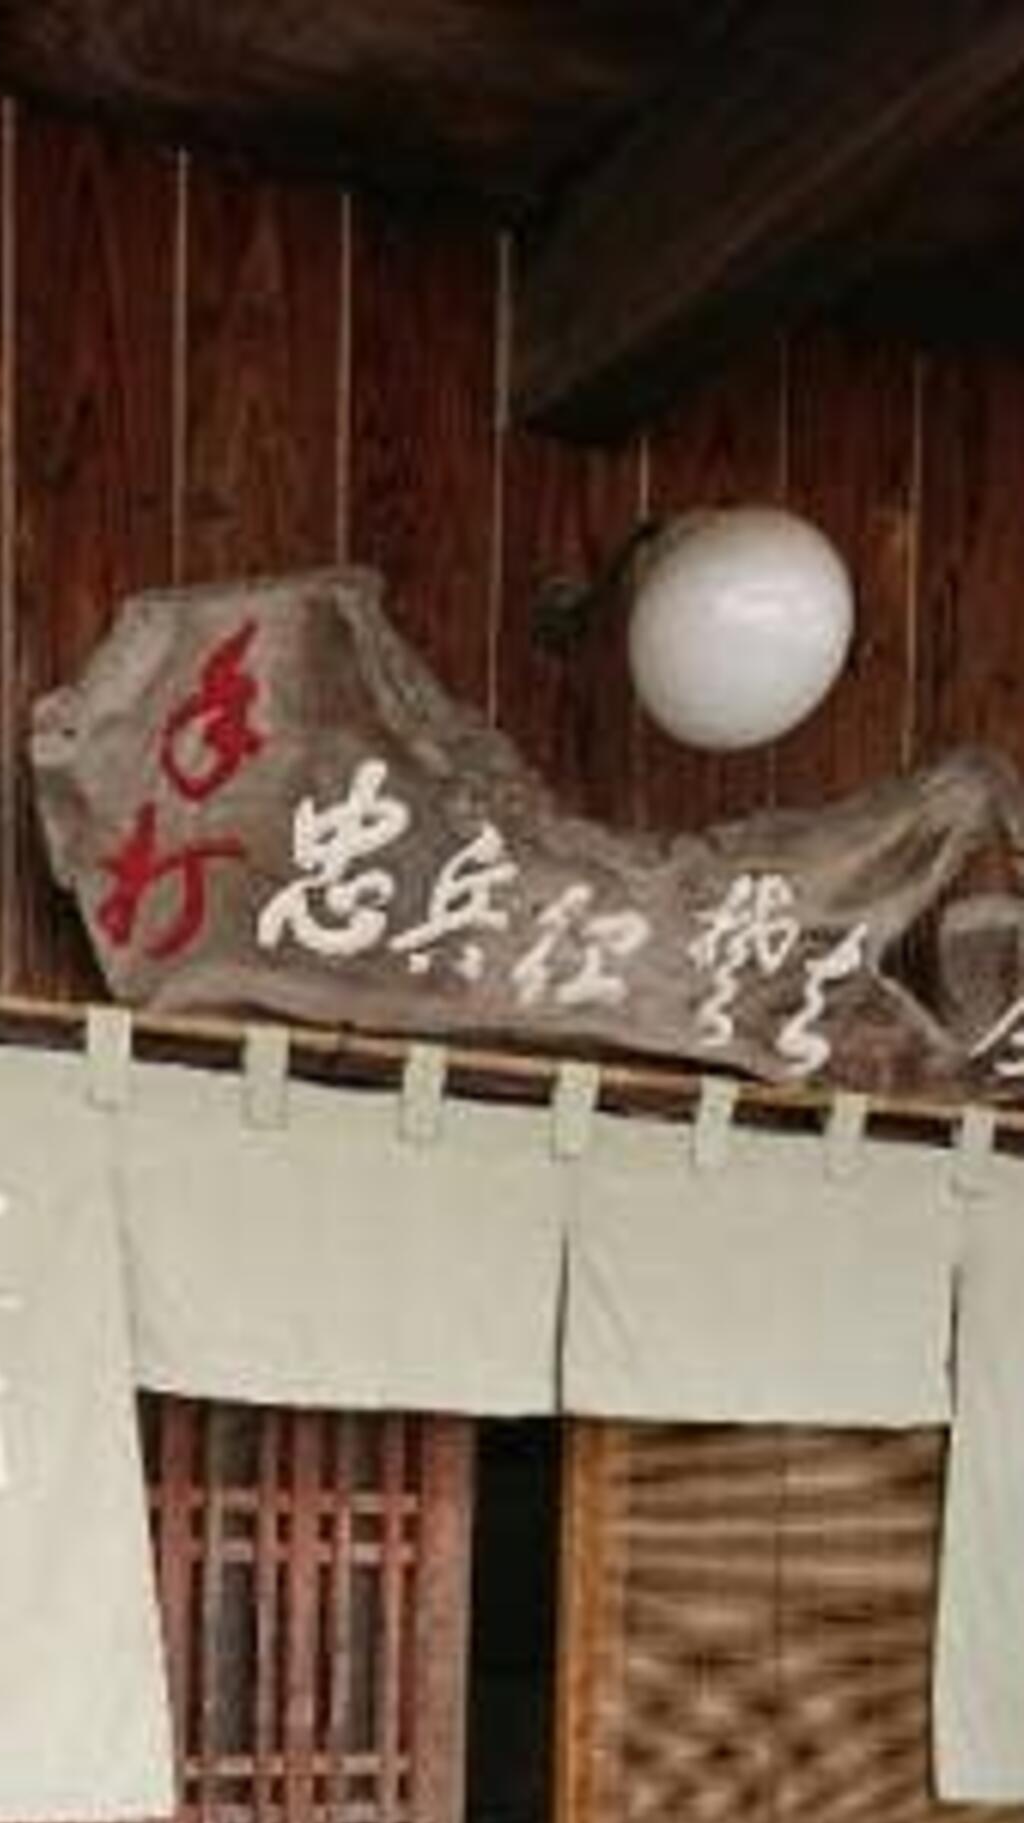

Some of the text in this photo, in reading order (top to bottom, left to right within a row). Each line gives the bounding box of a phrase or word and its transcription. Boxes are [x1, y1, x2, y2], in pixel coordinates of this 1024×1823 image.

[96, 615, 267, 961] 手打
[255, 757, 652, 1003] 忠兵衛
